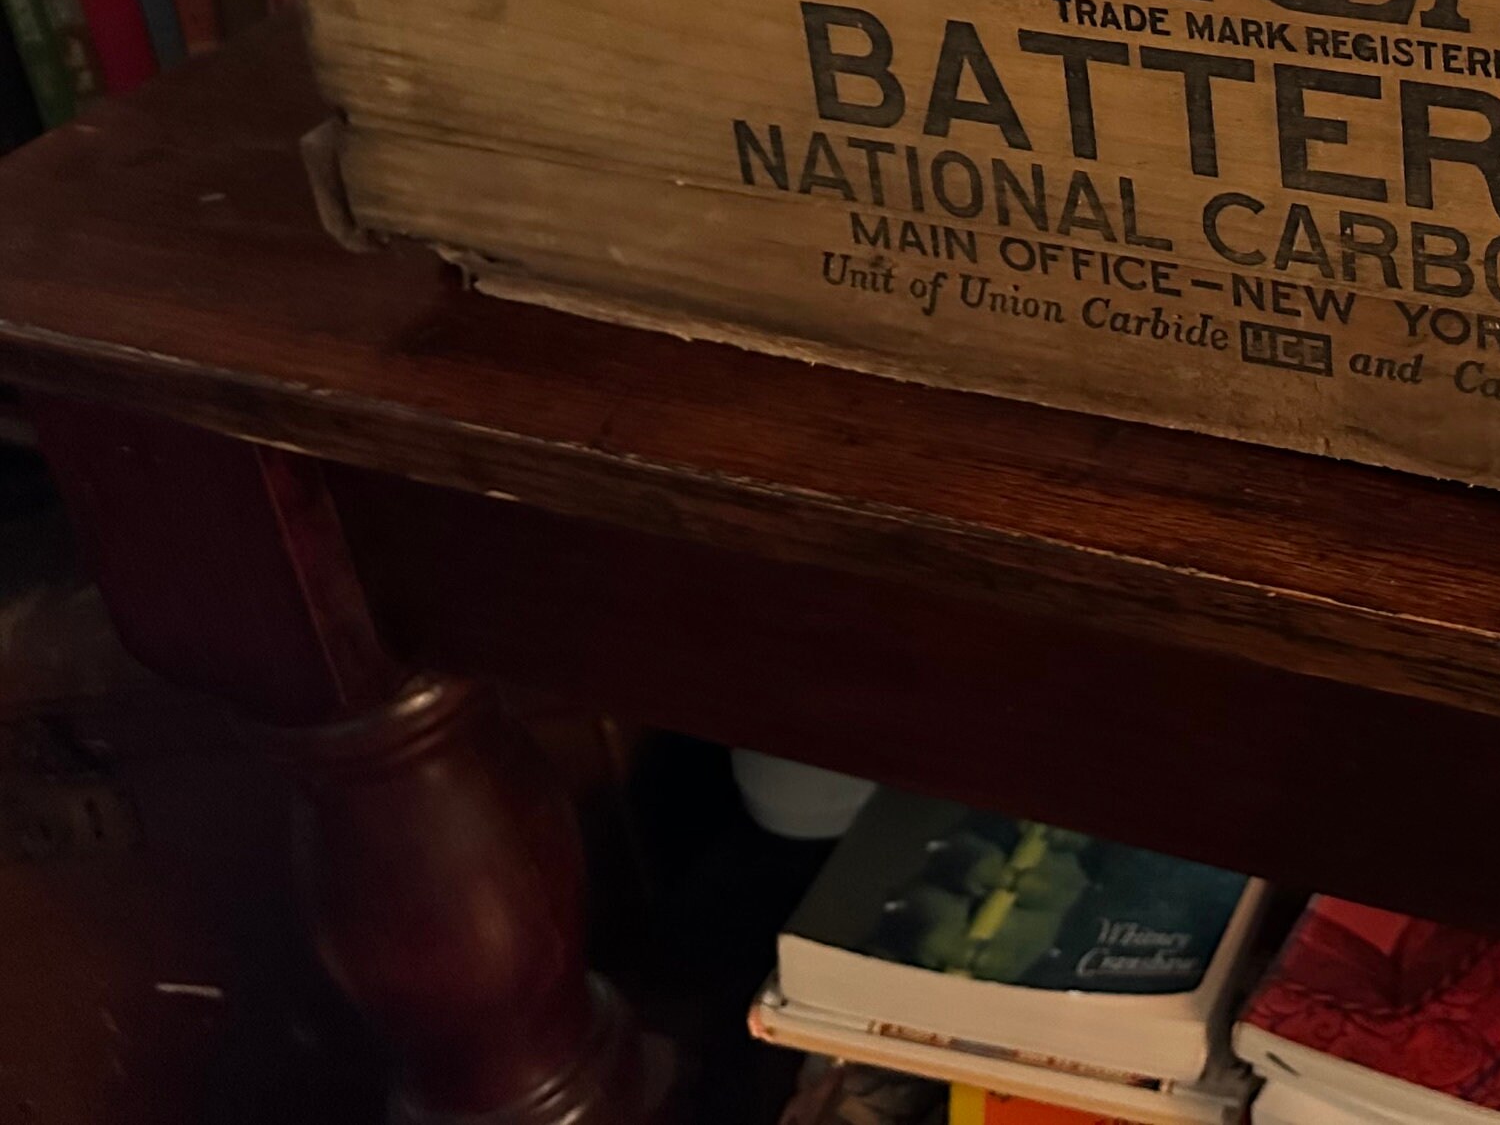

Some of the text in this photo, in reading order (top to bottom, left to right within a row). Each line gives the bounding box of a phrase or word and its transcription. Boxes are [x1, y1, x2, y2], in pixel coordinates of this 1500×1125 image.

[1186, 12, 1298, 53] MARK
[733, 119, 1173, 251] NATIONAL
[850, 212, 978, 264] MAIN
[822, 251, 896, 295] Unit
[909, 271, 948, 316] of
[959, 274, 1066, 324] Union
[1081, 297, 1230, 351] Carbide
[1349, 347, 1424, 386] and
